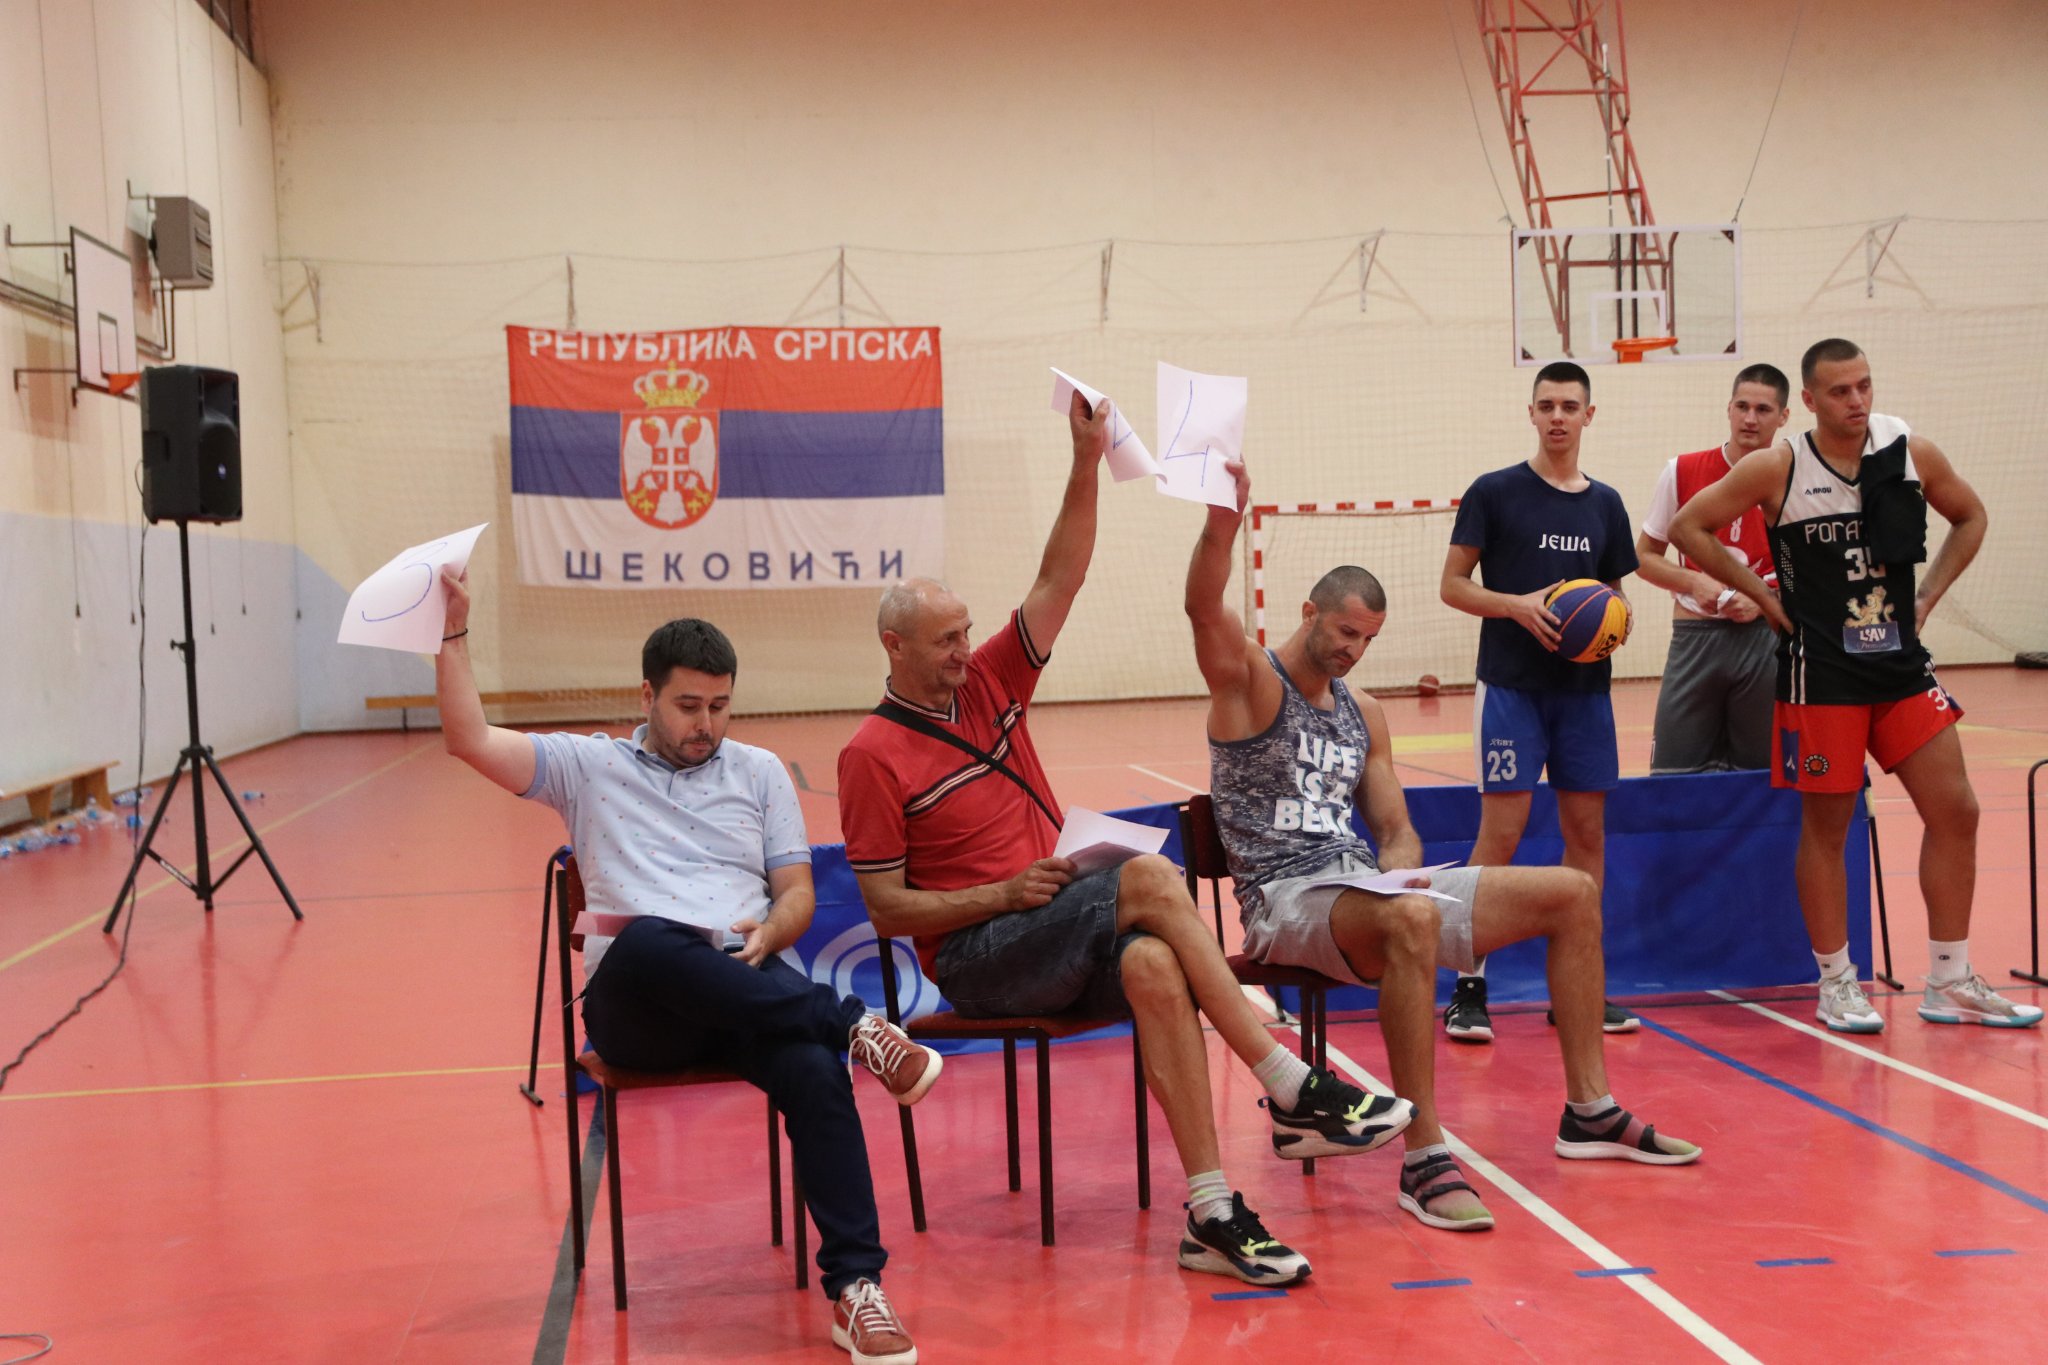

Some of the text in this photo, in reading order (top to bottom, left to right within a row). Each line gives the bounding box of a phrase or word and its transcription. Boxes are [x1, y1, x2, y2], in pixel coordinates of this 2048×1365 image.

[528, 328, 933, 362] РЕПУБЛИКА СРПСКА
[1165, 379, 1210, 487] 4
[1805, 519, 1863, 544] РОГА
[565, 550, 904, 581] ШЕКОВИЋИ
[1297, 731, 1357, 778] LIFE
[1487, 749, 1517, 782] 23
[1295, 767, 1323, 801] IS
[1274, 799, 1357, 838] BEAC
